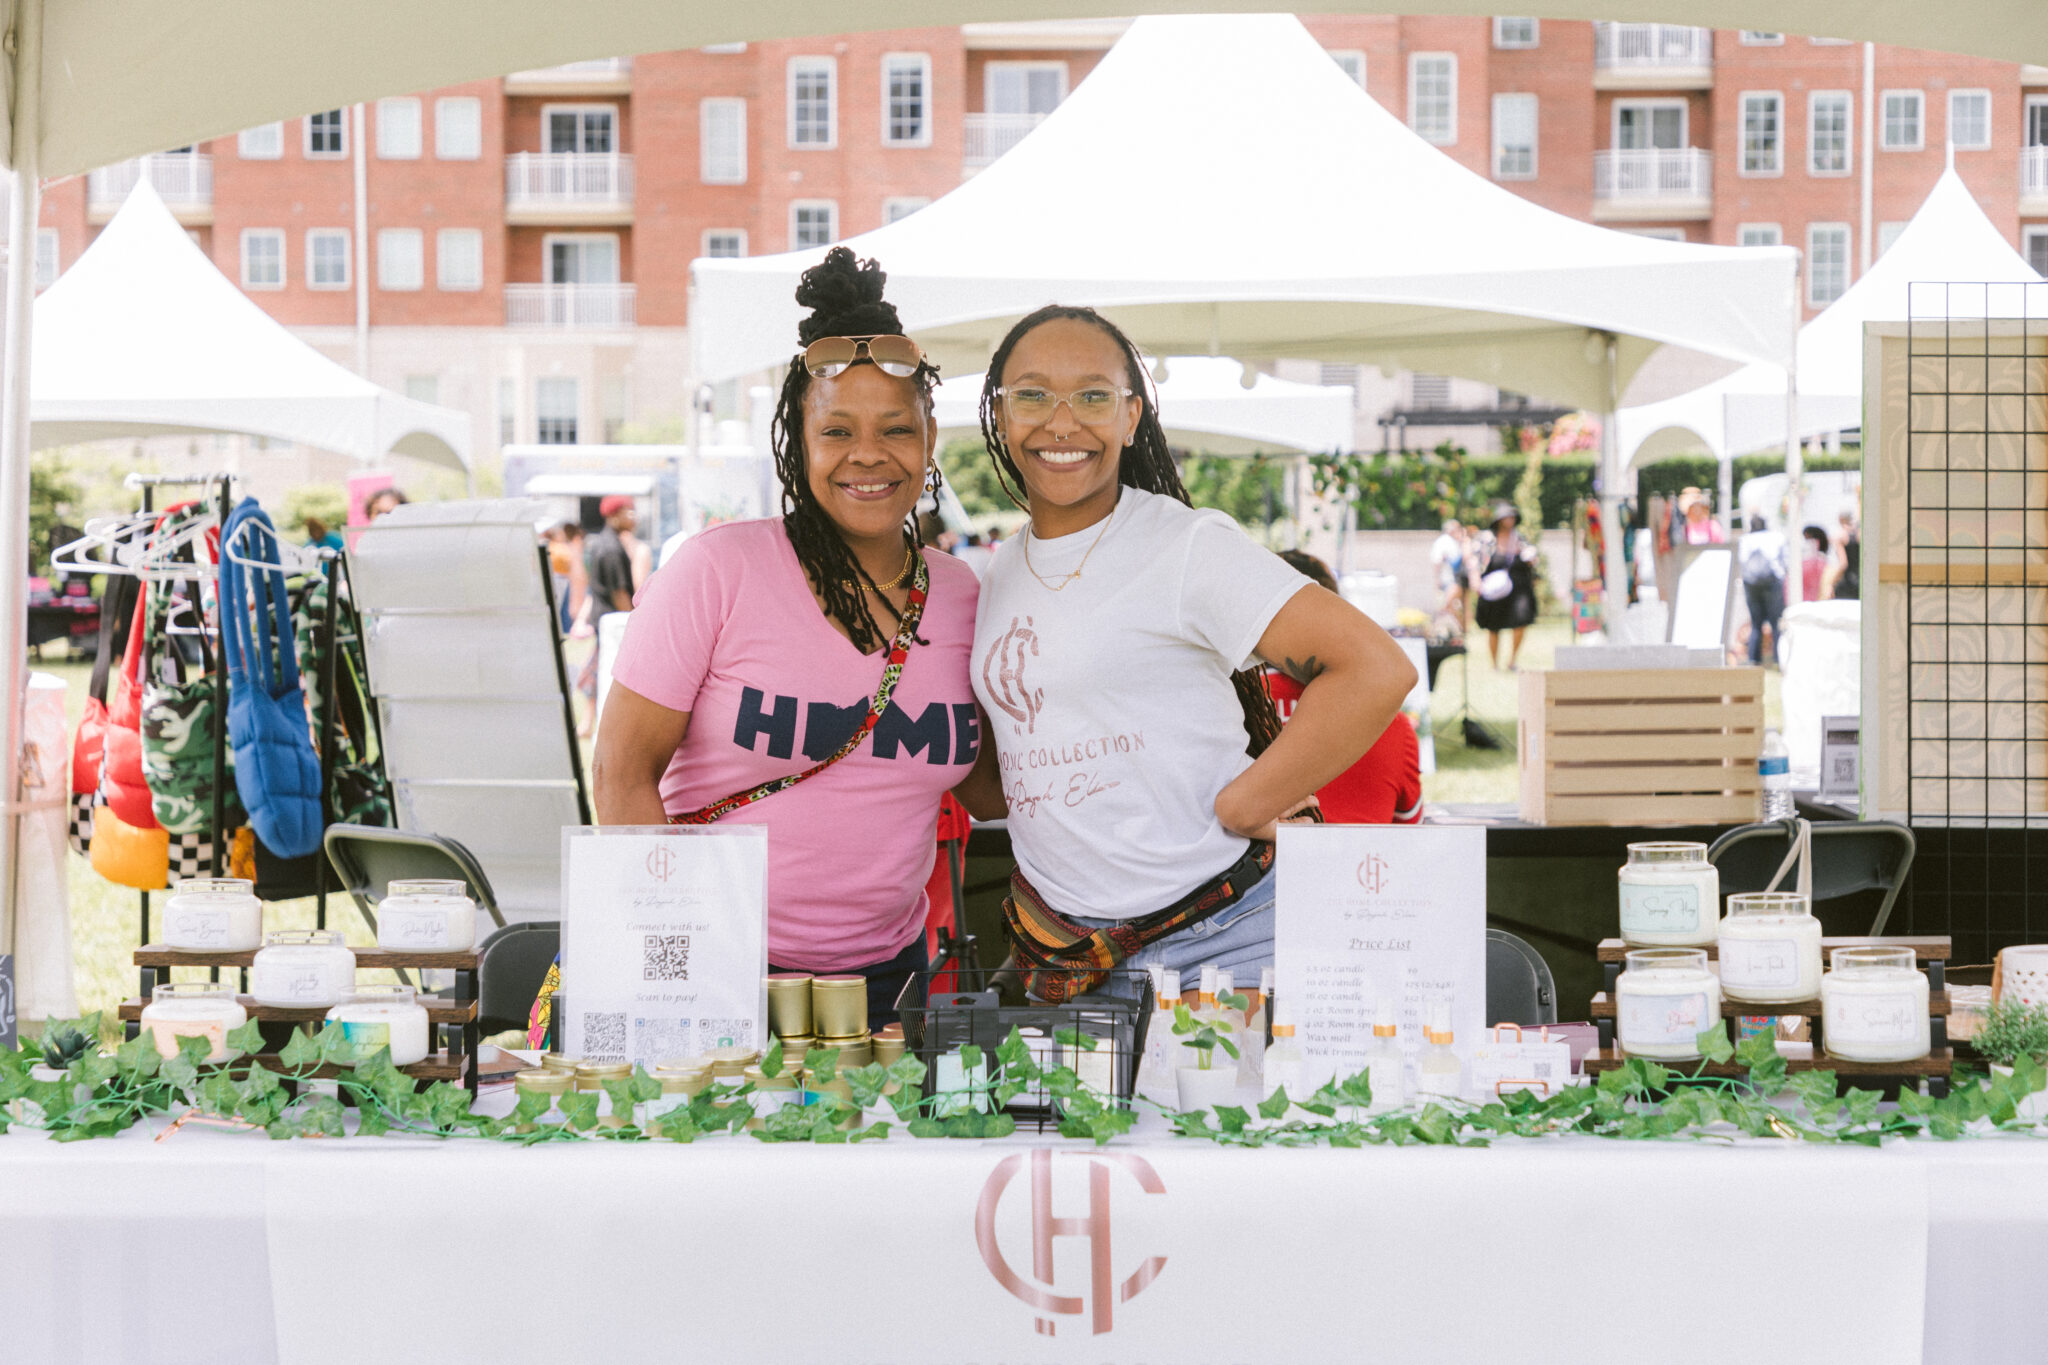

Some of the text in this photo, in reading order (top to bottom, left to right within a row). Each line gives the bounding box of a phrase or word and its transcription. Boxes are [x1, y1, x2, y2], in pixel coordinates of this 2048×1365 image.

[1029, 730, 1145, 768] COLLECTION
[626, 922, 711, 932] Connect with us!
[1349, 938, 1412, 950] Price List
[1334, 965, 1365, 973] candle
[1331, 979, 1364, 987] candle
[635, 993, 698, 1004] Scan to pay!
[1331, 993, 1363, 1001] candle
[1327, 1006, 1354, 1014] Room
[1327, 1020, 1355, 1029] Room
[1305, 1034, 1329, 1043] Wax
[1305, 1048, 1328, 1057] Wick
